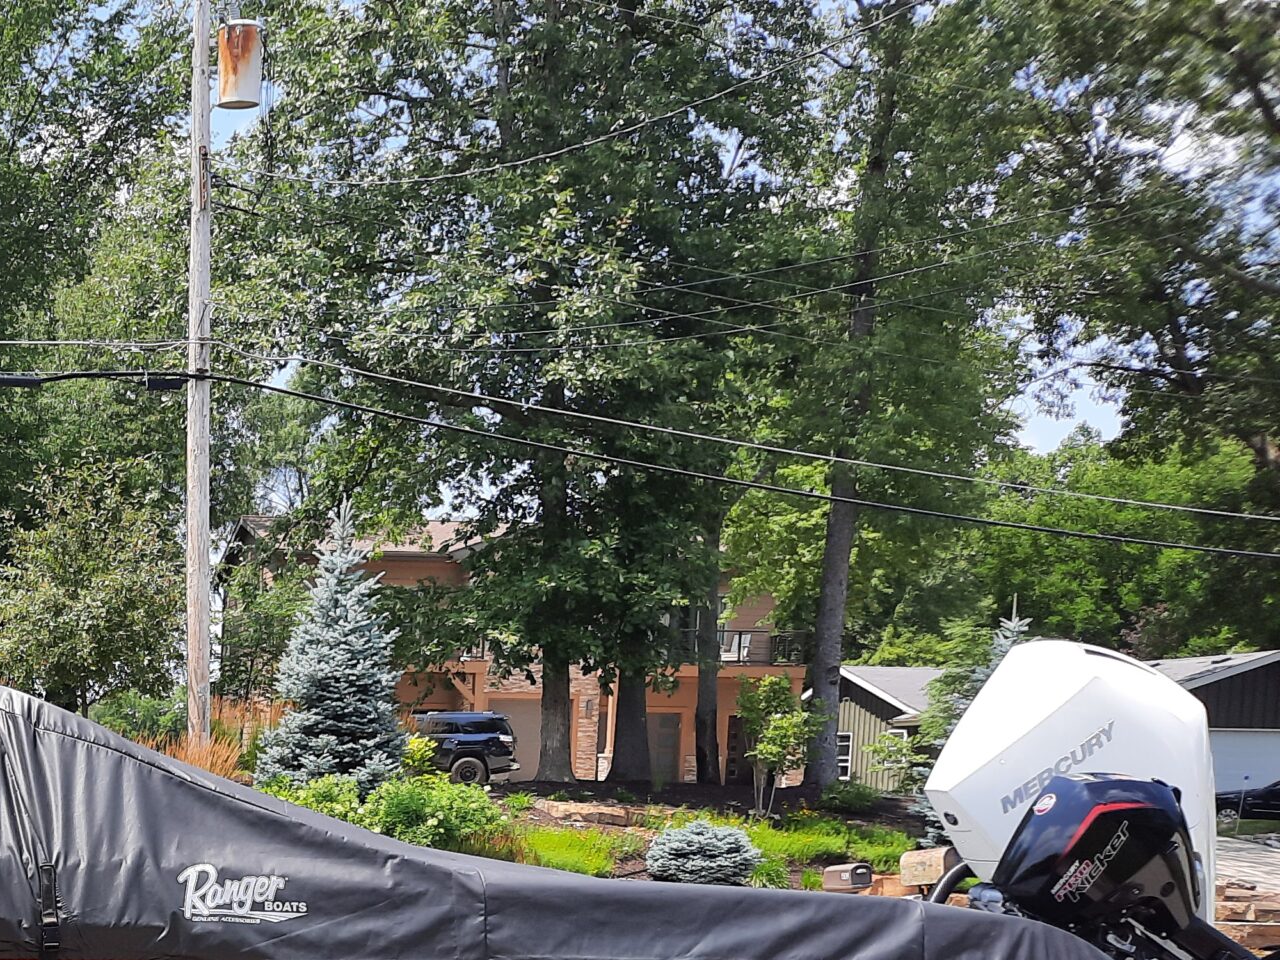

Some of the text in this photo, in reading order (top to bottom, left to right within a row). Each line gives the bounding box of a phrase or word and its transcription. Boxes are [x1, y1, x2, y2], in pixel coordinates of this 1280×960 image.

[1000, 719, 1115, 815] MERCURY
[176, 863, 286, 920] Ranger
[1050, 859, 1080, 895] MERCURY
[263, 901, 308, 913] BOATS
